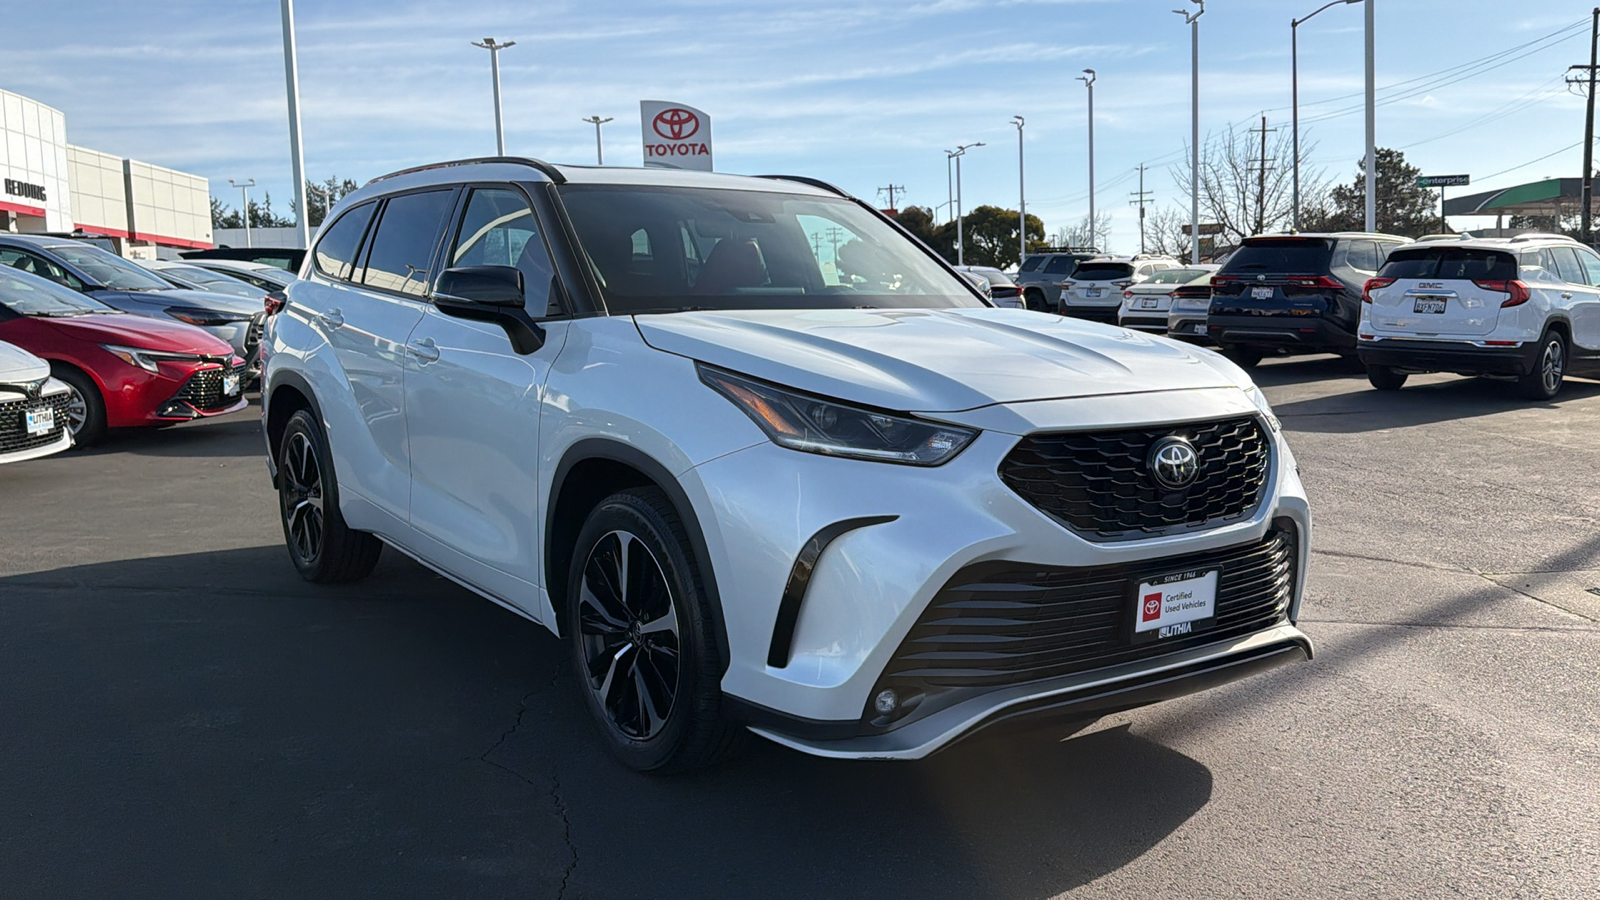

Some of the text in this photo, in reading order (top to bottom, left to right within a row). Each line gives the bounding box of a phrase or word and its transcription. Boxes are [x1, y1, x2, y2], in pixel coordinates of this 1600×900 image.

[645, 142, 710, 157] TOYOTA
[1422, 176, 1468, 185] enterprise
[4, 178, 47, 202] REDDING
[33, 411, 53, 424] LITHIA
[1163, 571, 1197, 583] SINCE 1946
[1165, 590, 1193, 603] Certified
[1164, 600, 1207, 614] Used Vehicles
[1166, 621, 1193, 637] LITHIA
